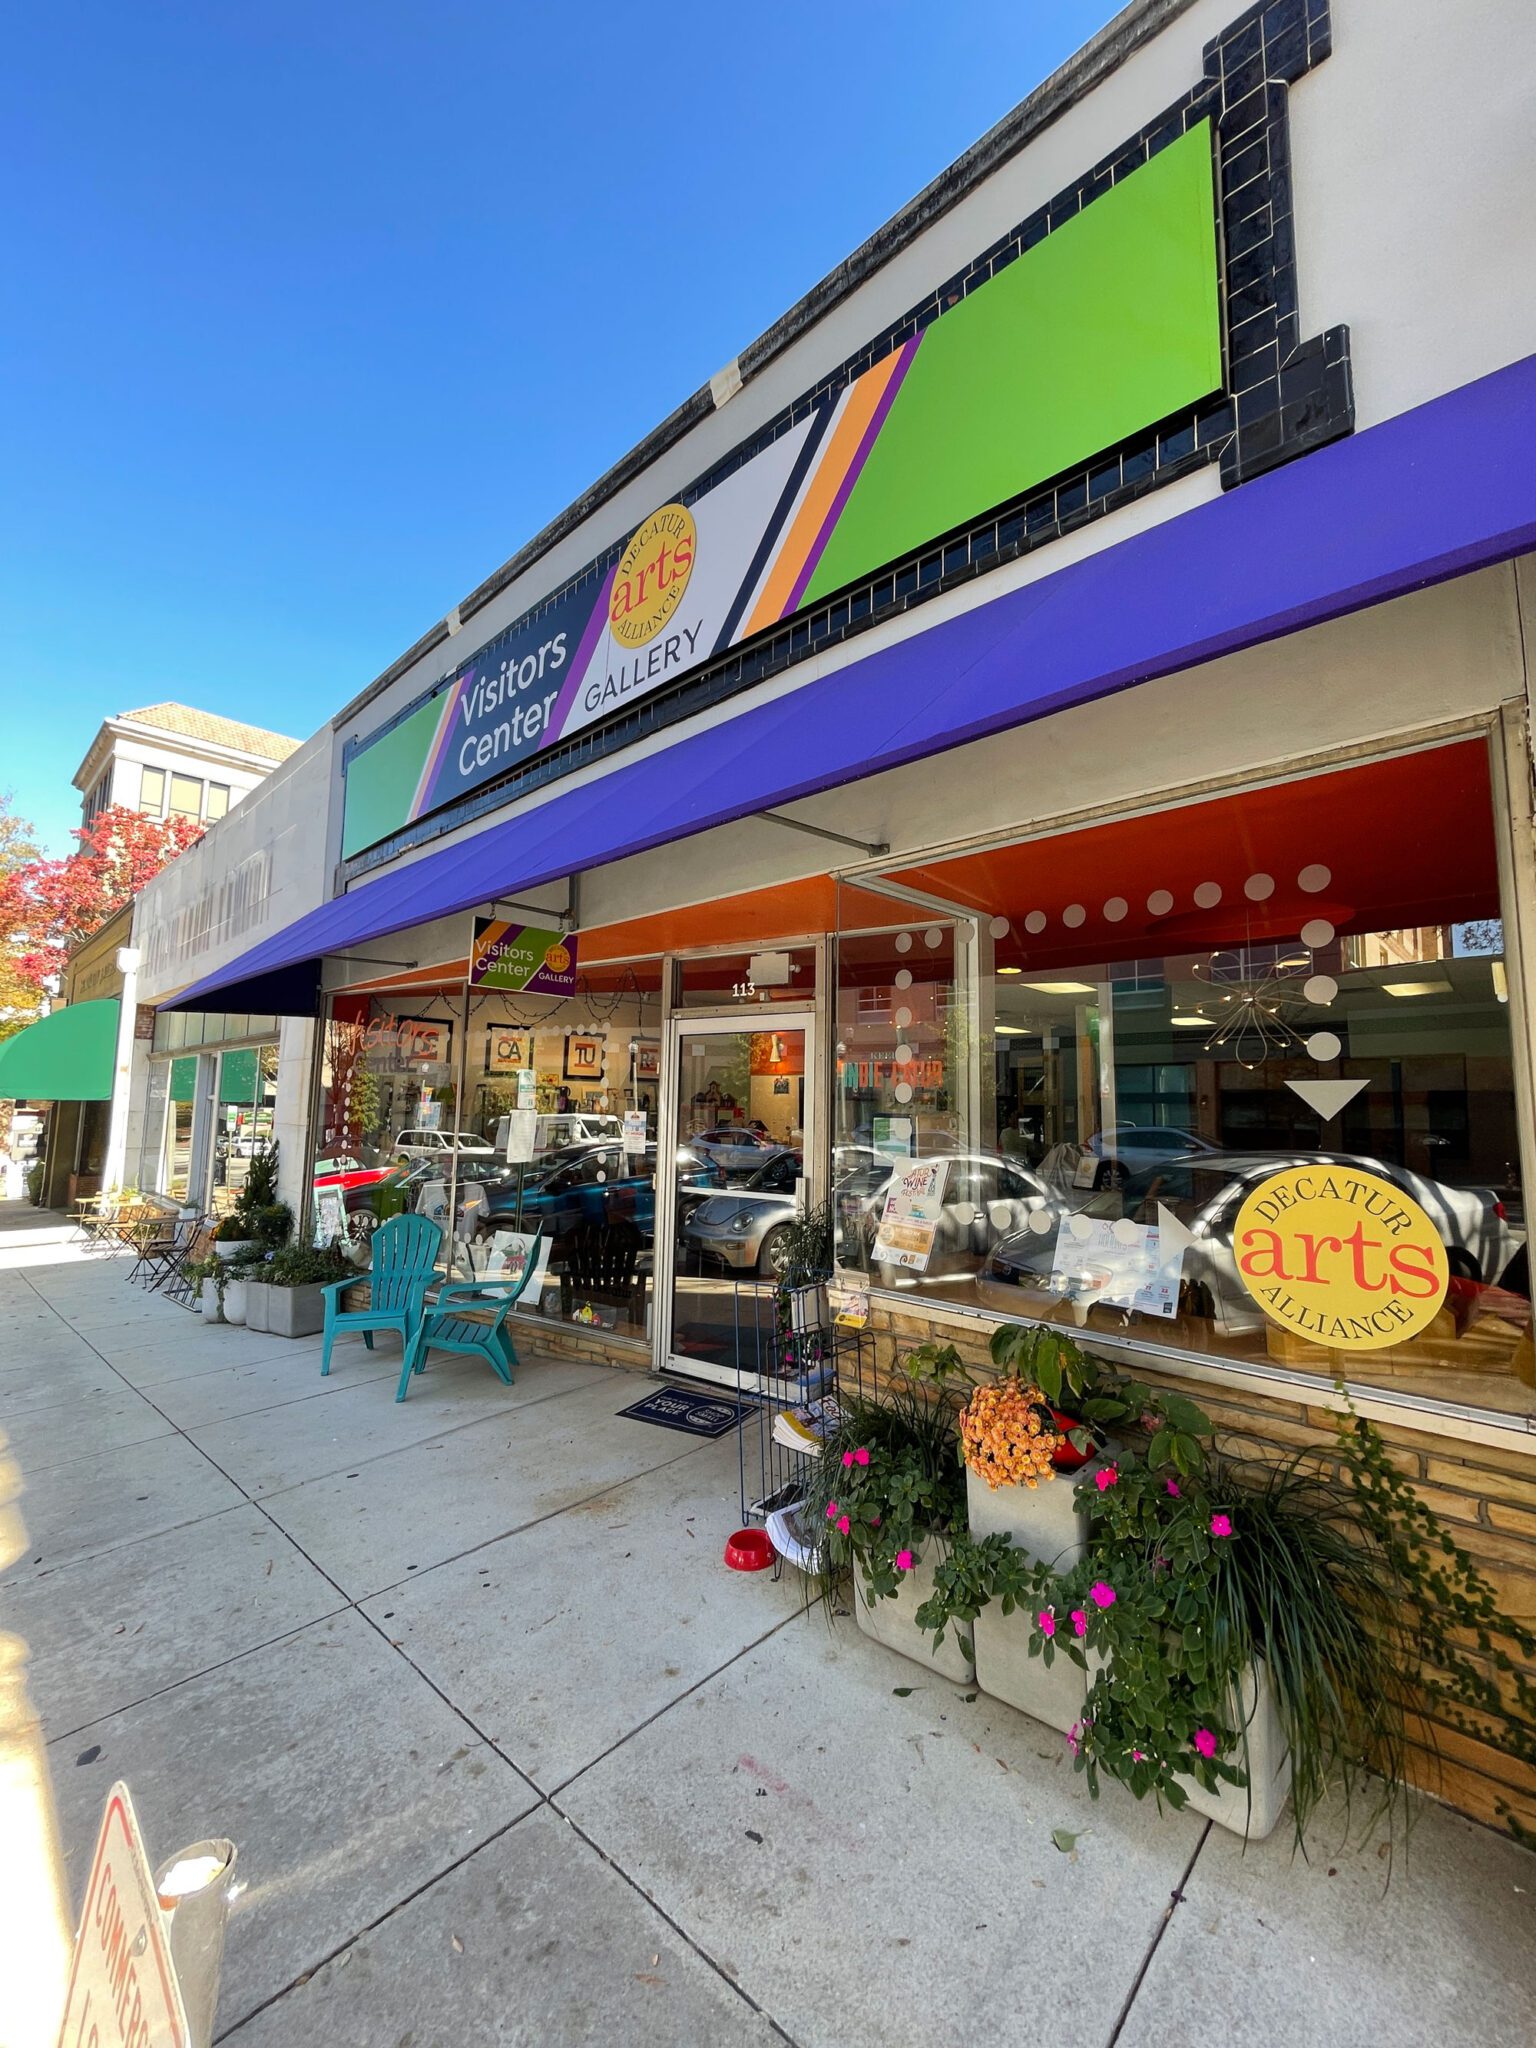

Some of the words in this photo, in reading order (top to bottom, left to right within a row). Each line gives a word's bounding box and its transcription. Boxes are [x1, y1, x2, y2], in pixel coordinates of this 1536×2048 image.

[622, 512, 688, 576] DECATUR
[611, 535, 694, 622] arts
[617, 584, 681, 642] ALLIANCE
[460, 631, 567, 726] Visitors
[585, 619, 706, 713] GALLERY
[459, 690, 558, 776] Center
[475, 939, 534, 961] Visitors
[475, 957, 530, 977] Center
[546, 951, 571, 965] arts
[538, 972, 575, 984] GALLERY
[732, 982, 756, 997] 113
[498, 1040, 522, 1060] CA
[1254, 1176, 1413, 1236] DECATUR
[1241, 1220, 1440, 1299] arts
[1260, 1286, 1414, 1340] ALLIANCE
[644, 1403, 683, 1416] PLACE
[654, 1398, 690, 1411] YOUR
